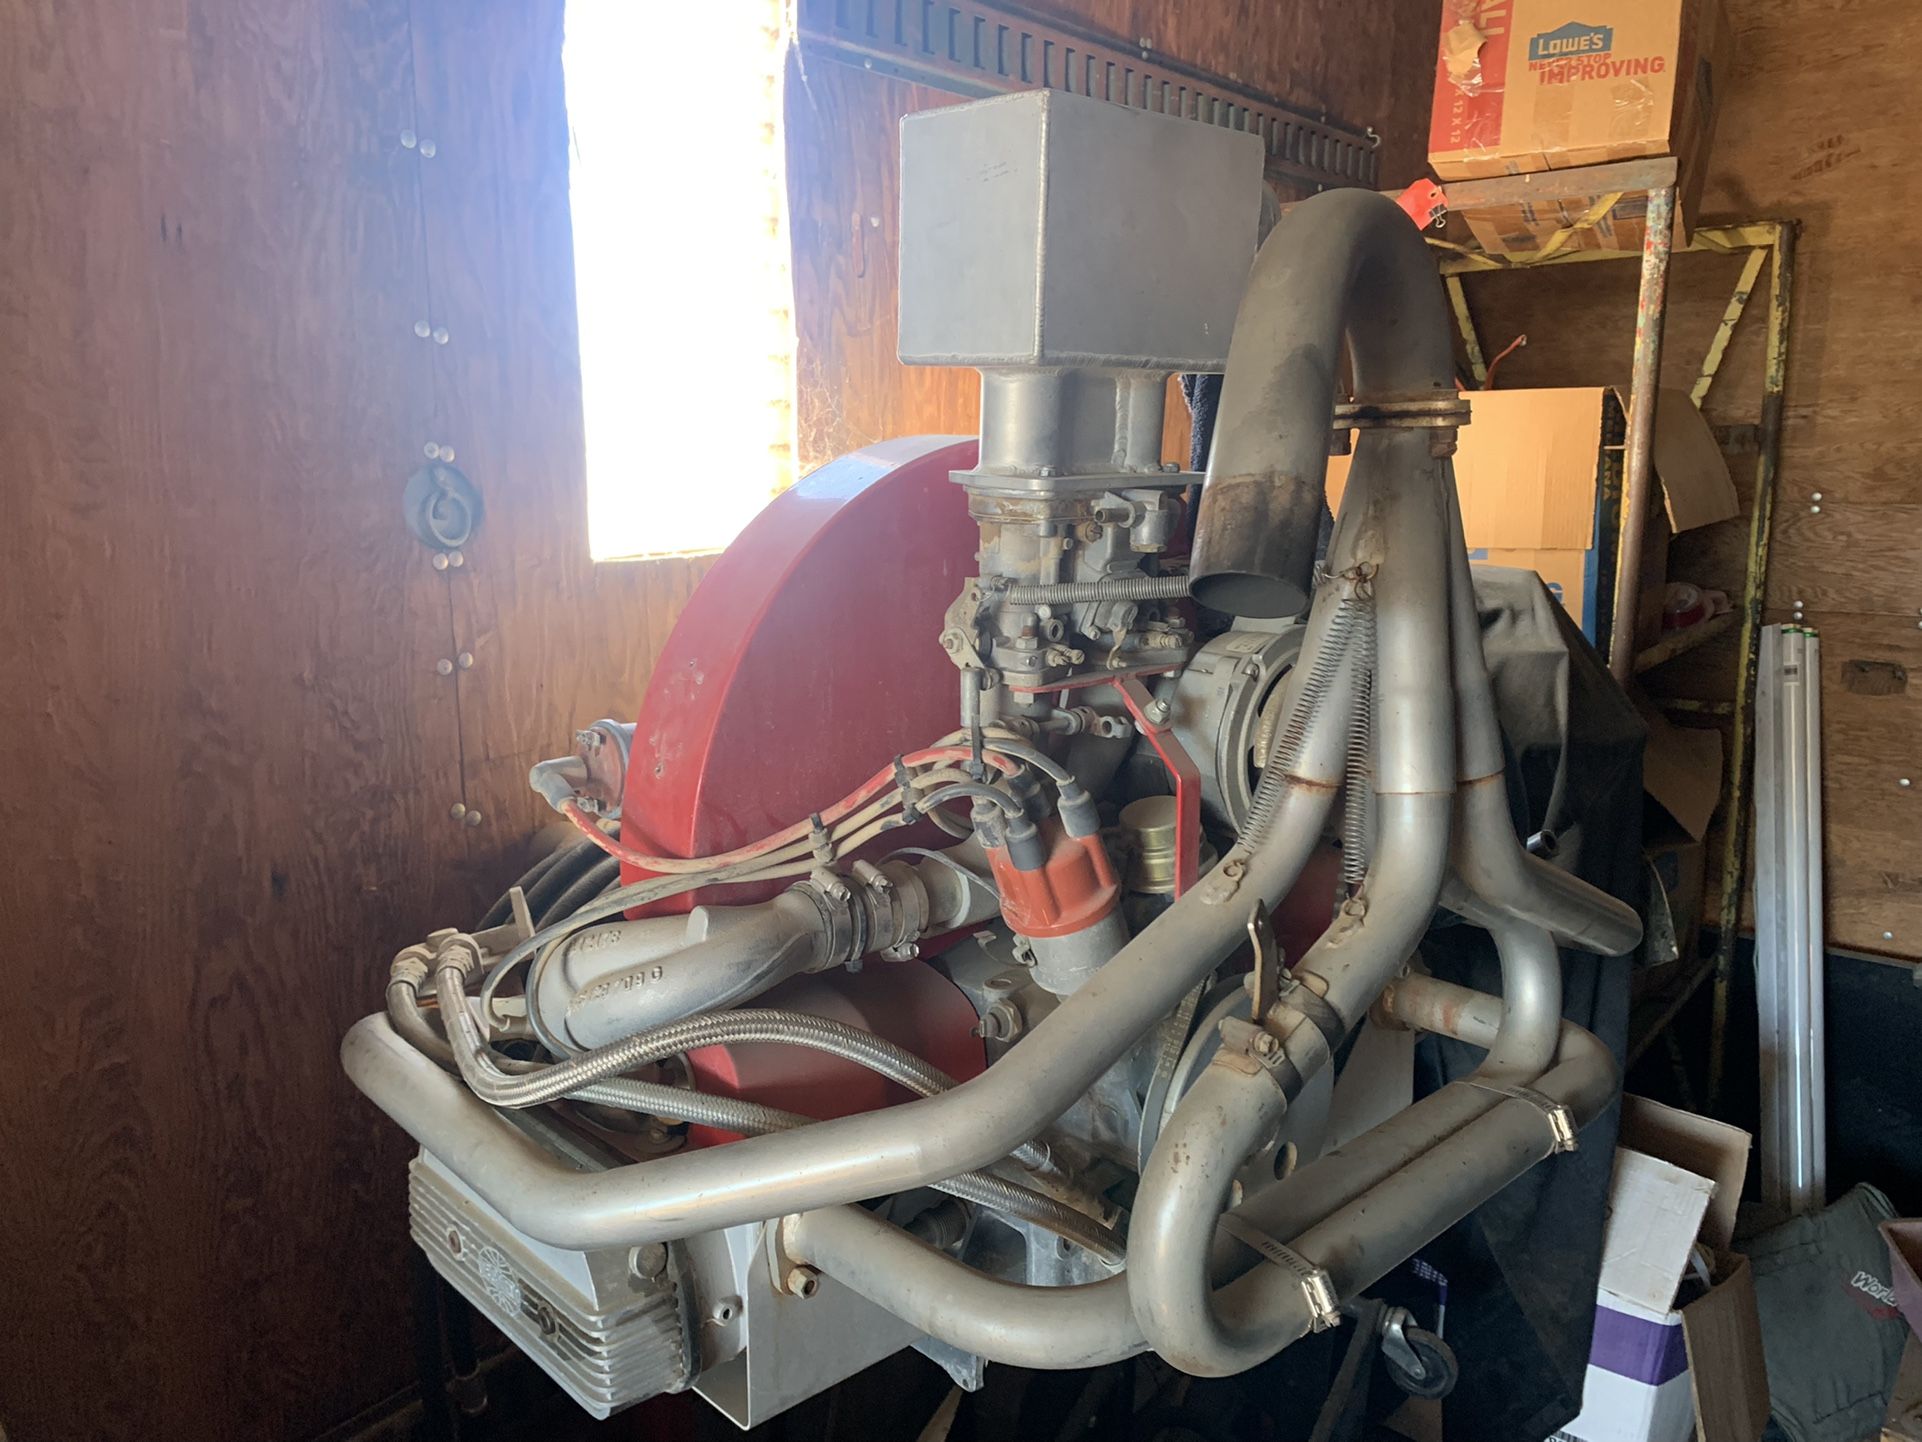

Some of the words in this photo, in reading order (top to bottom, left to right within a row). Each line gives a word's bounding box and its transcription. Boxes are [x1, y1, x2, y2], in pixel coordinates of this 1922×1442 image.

[1537, 32, 1604, 55] LOWE'S
[1575, 52, 1612, 66] STOP
[1540, 56, 1665, 85] IMPROVING
[1453, 100, 1464, 114] 12
[1450, 129, 1461, 144] 12
